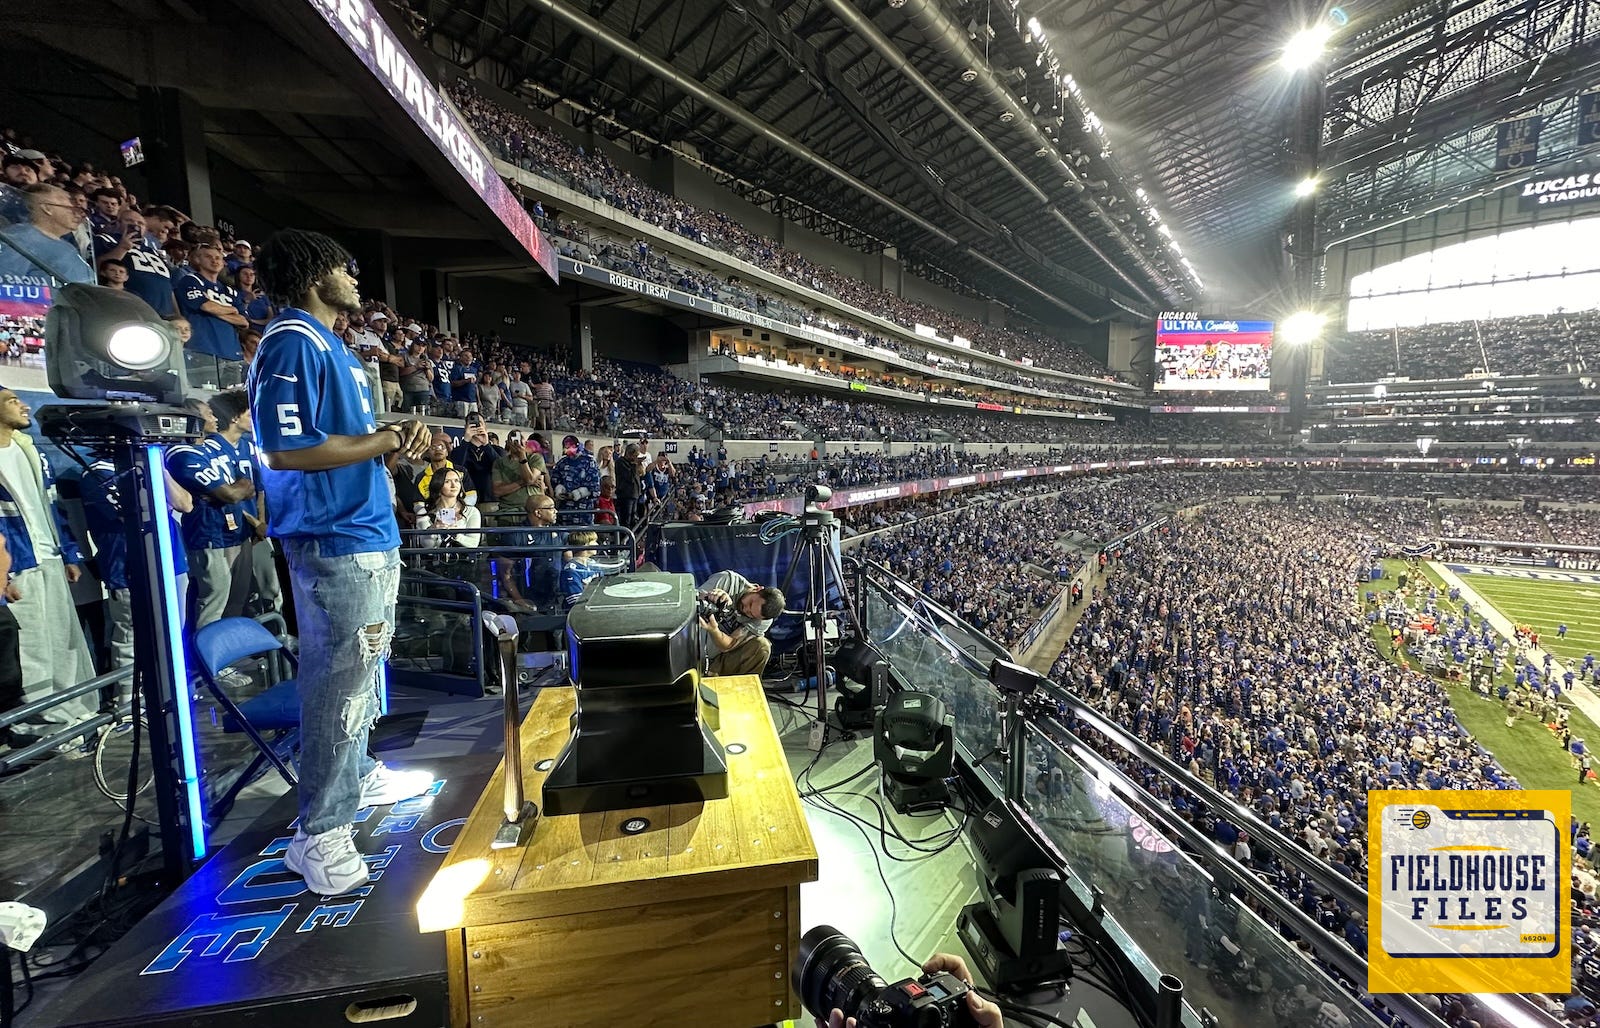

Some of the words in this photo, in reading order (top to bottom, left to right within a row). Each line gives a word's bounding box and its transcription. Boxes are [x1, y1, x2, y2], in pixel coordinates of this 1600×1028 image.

[370, 17, 486, 191] WALKER
[1521, 174, 1591, 197] LUCAS
[1538, 187, 1600, 204] STADIU
[217, 219, 235, 235] 406
[127, 248, 171, 280] 28
[609, 273, 645, 292] ROBERT
[646, 283, 670, 300] IRSAY
[712, 303, 728, 317] BILL
[728, 309, 751, 324] BROOKS
[1158, 311, 1184, 320] LUCAS
[1185, 311, 1199, 320] OIL
[1164, 320, 1203, 331] ULTRA
[276, 403, 303, 437] 5
[665, 443, 677, 453] 307
[194, 467, 221, 486] 00
